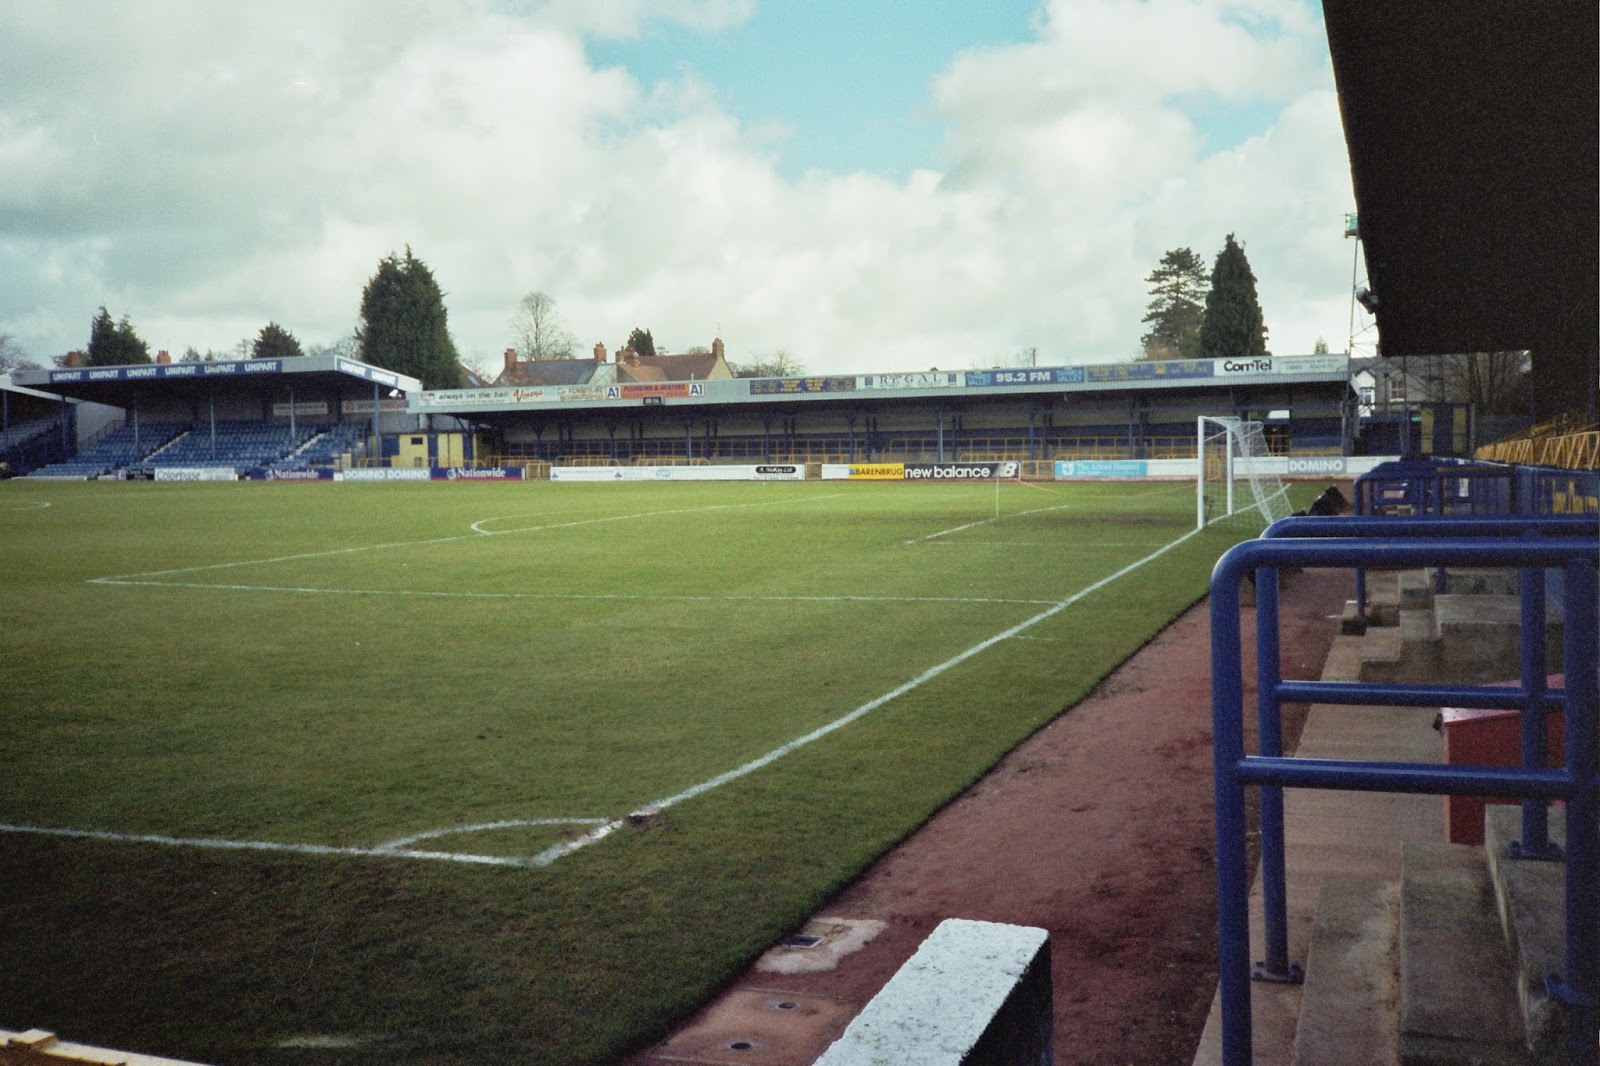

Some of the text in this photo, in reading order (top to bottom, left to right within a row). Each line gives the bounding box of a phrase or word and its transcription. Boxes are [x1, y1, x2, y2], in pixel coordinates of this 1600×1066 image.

[164, 366, 196, 375] UNIPART
[204, 364, 236, 374] UNIPART
[244, 362, 277, 372] UNIPART
[53, 372, 81, 381] UNIPART
[89, 370, 118, 379] UNIPART
[127, 368, 156, 377] UNIPART
[996, 372, 1051, 382] 95.2 FM
[880, 374, 941, 384] REGAL
[494, 390, 509, 398] ball
[607, 386, 619, 398] A1
[690, 384, 703, 395] A1
[1289, 460, 1343, 471] DOMINO
[157, 470, 201, 480] Colorbase
[274, 469, 319, 479] Nationwide
[344, 469, 430, 479] DOMINO DOMINO
[458, 467, 506, 478] Nationwide
[855, 468, 903, 476] BARENBRUG
[905, 465, 990, 478] new balance
